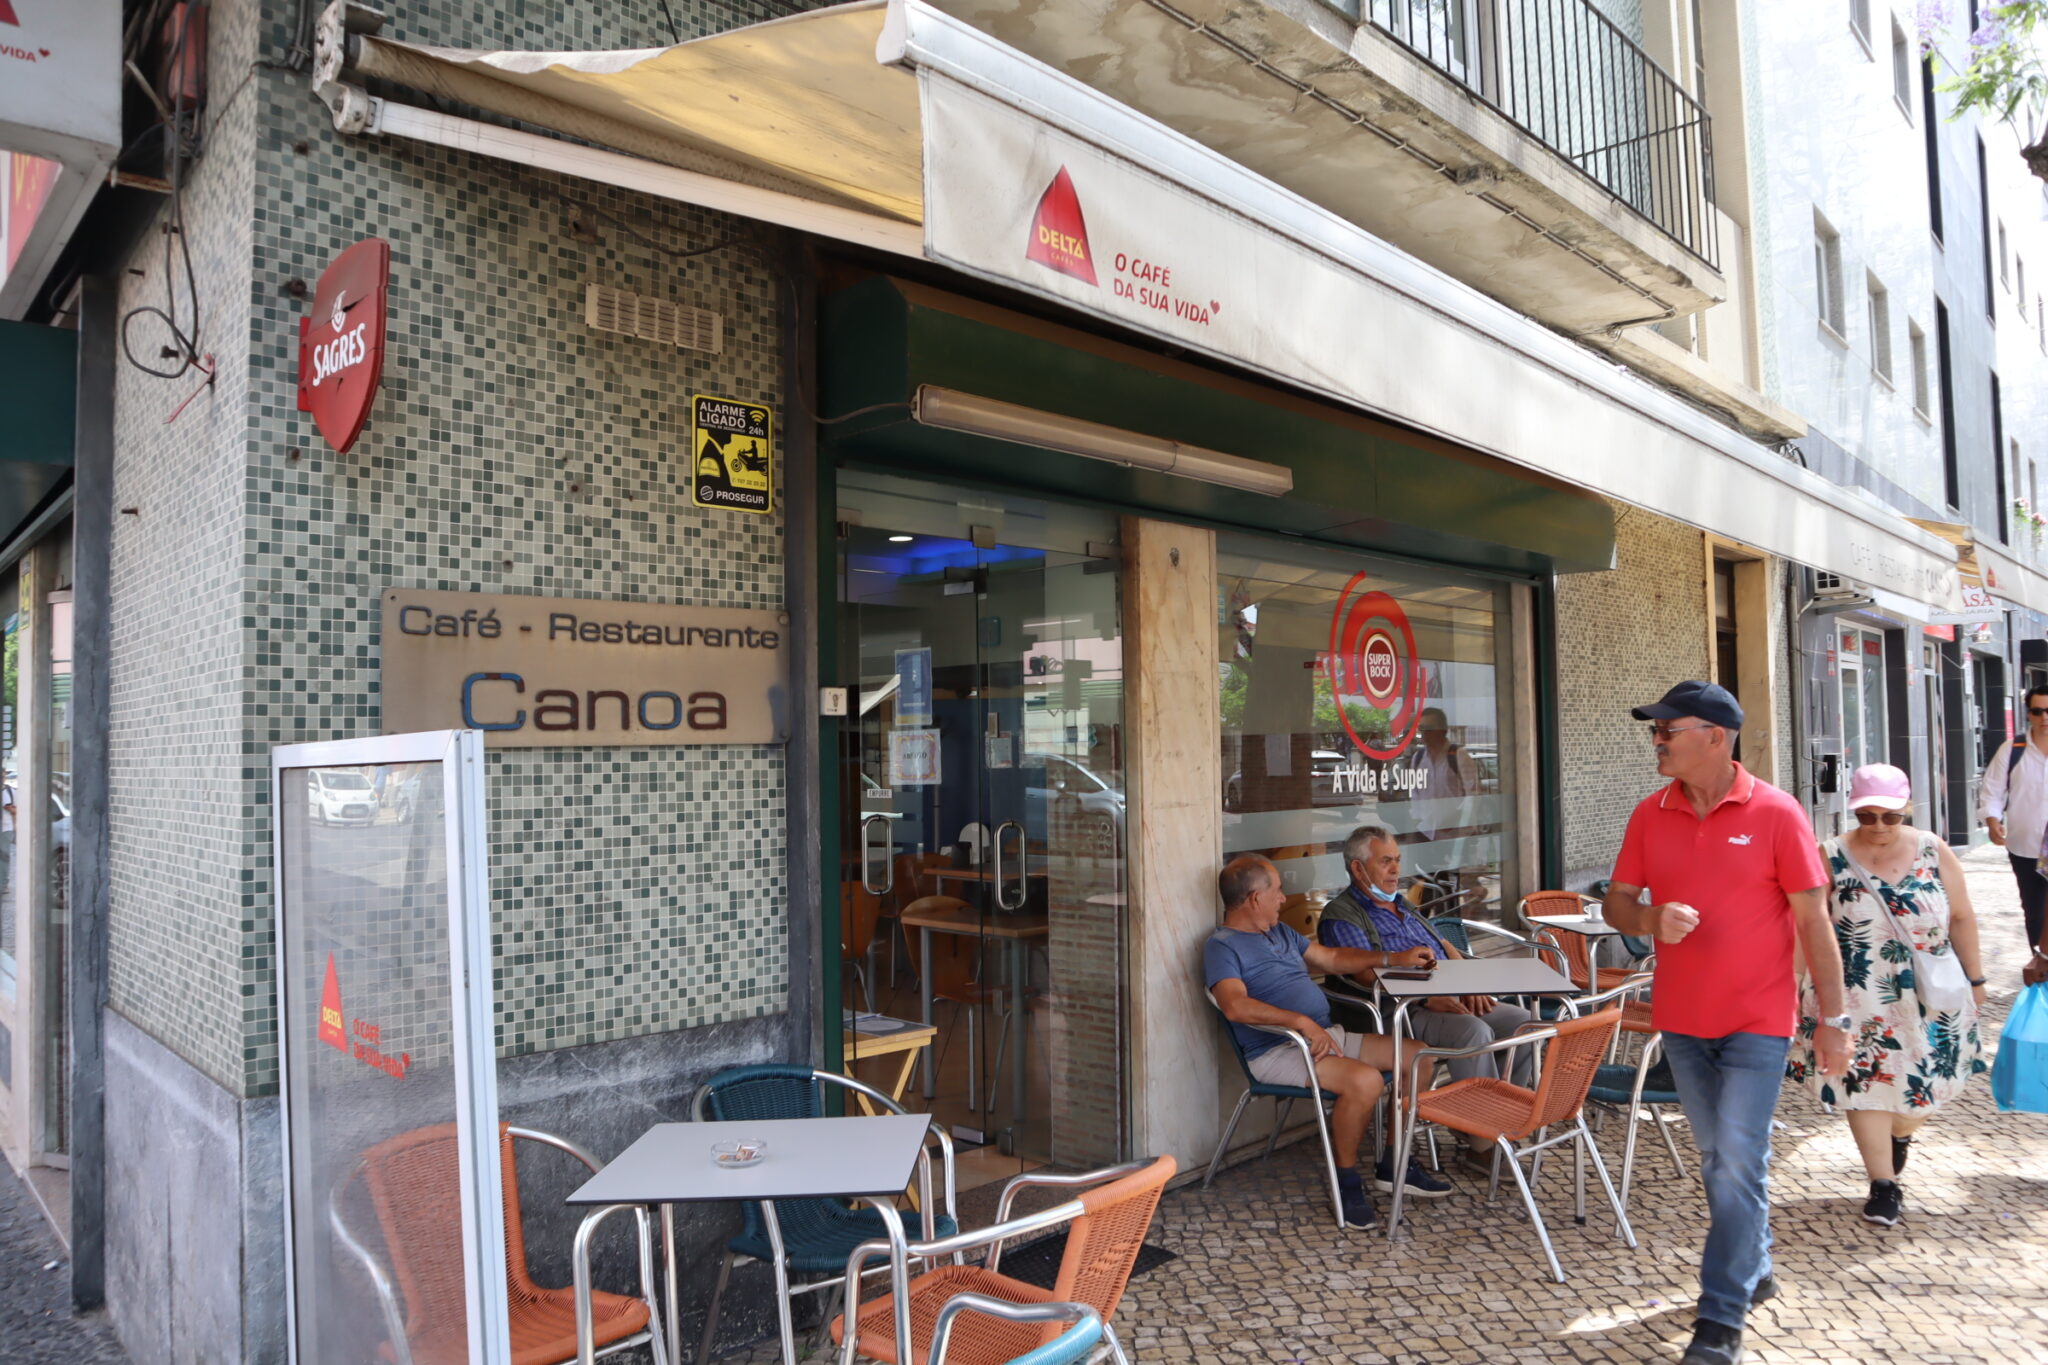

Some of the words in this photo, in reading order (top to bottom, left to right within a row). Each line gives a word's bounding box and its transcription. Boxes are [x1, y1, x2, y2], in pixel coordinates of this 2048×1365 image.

[1038, 224, 1085, 260] DELTA
[1114, 253, 1127, 272] O
[1131, 259, 1171, 287] CAFÉ
[1113, 278, 1135, 302] DA
[1139, 287, 1169, 313] SUA
[1174, 298, 1210, 326] VIDA
[312, 322, 366, 387] SAGRES
[699, 402, 746, 418] ALARME
[699, 411, 747, 429] LIGADO
[748, 426, 765, 436] 24h
[716, 490, 765, 505] PROSEGUR
[399, 605, 502, 638] Café
[548, 612, 780, 650] Restaurante
[1368, 652, 1391, 666] SUPER
[1369, 665, 1391, 678] BOCK
[460, 672, 728, 732] Canoa
[1332, 765, 1343, 793] A
[1346, 762, 1377, 793] Vida
[1380, 763, 1389, 790] é
[1392, 764, 1429, 798] Super
[322, 1006, 343, 1029] DELTA
